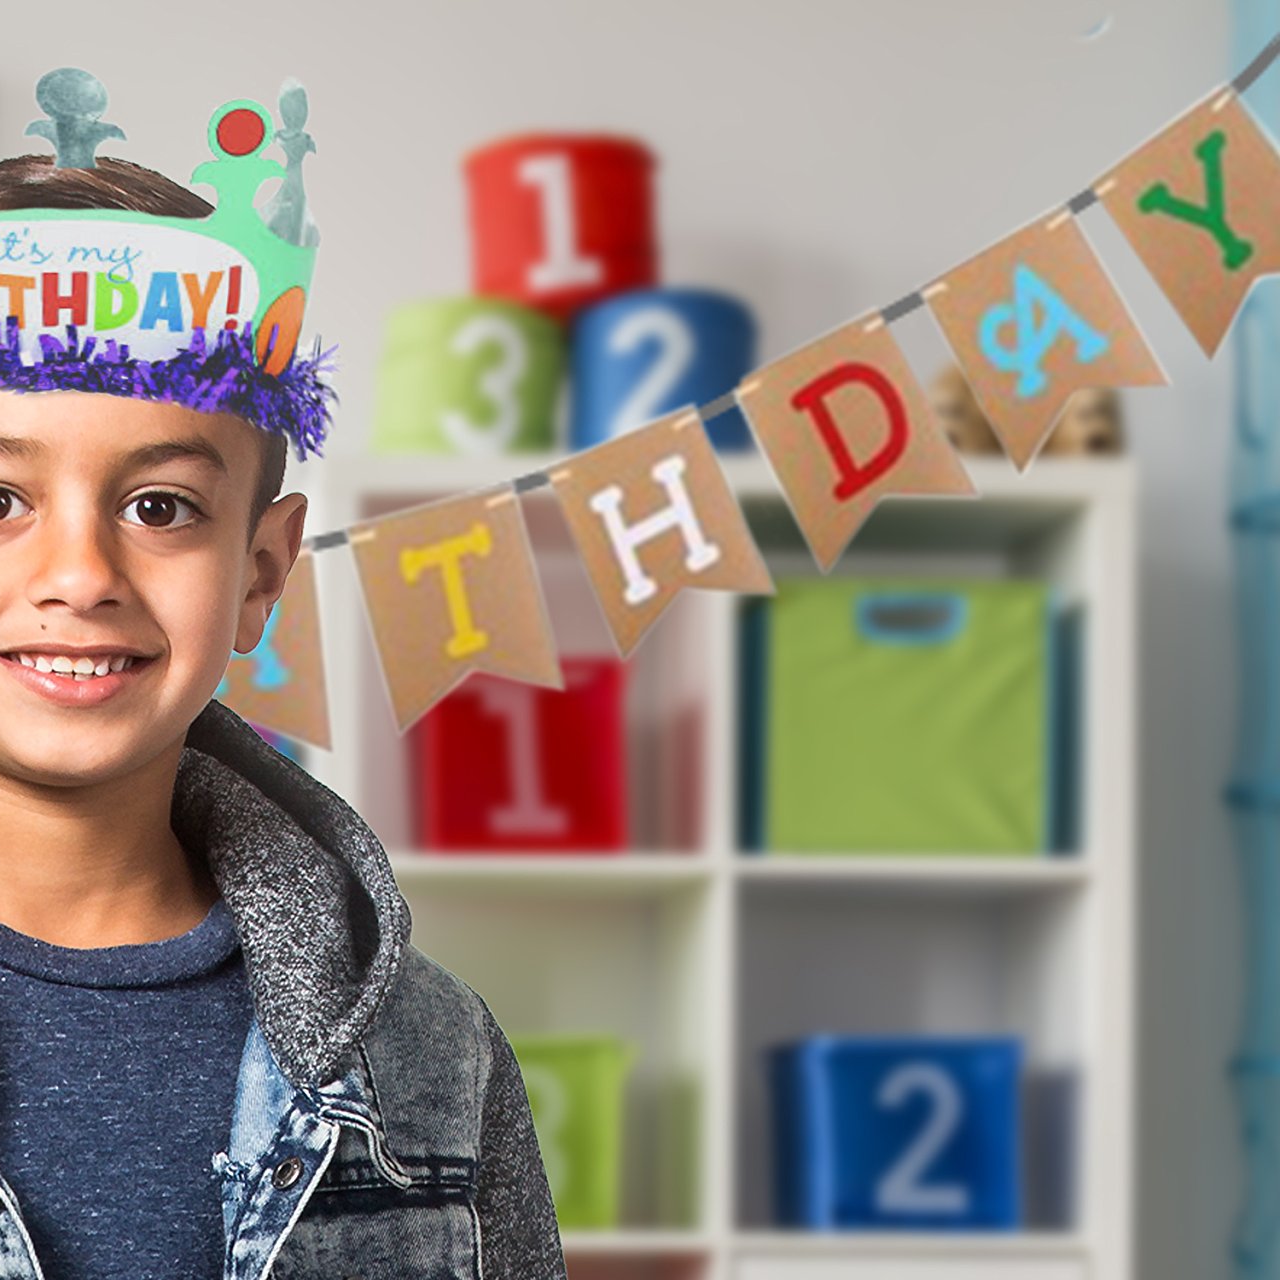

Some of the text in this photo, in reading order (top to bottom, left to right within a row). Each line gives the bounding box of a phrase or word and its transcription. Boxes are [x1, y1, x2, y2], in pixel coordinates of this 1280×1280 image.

[67, 245, 142, 284] my
[516, 153, 603, 291] 1
[440, 312, 528, 458] 3
[608, 307, 694, 437] 2
[483, 684, 567, 833] 1
[878, 1062, 969, 1212] 2
